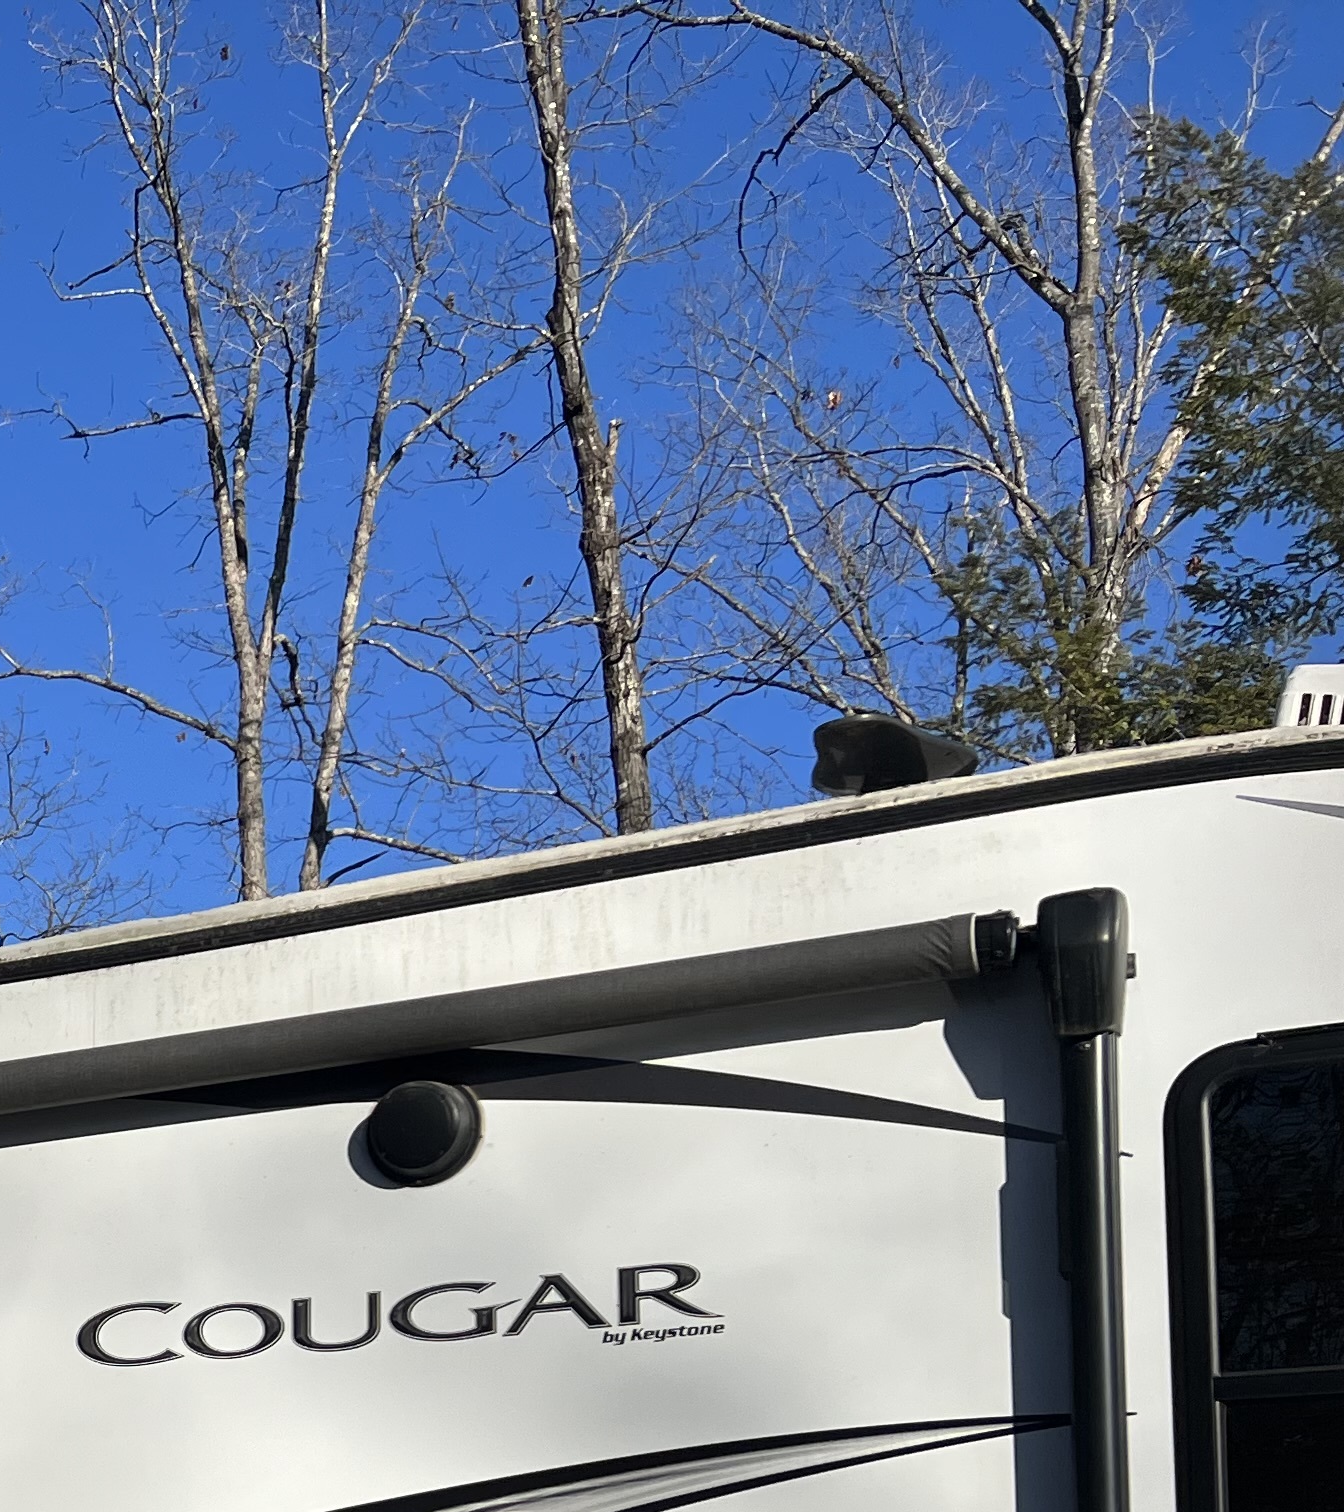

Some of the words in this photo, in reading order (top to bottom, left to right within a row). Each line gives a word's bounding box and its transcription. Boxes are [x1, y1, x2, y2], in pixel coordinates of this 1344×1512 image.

[76, 1262, 725, 1367] COUGAR
[602, 1331, 627, 1346] by
[630, 1323, 725, 1343] Keystone
